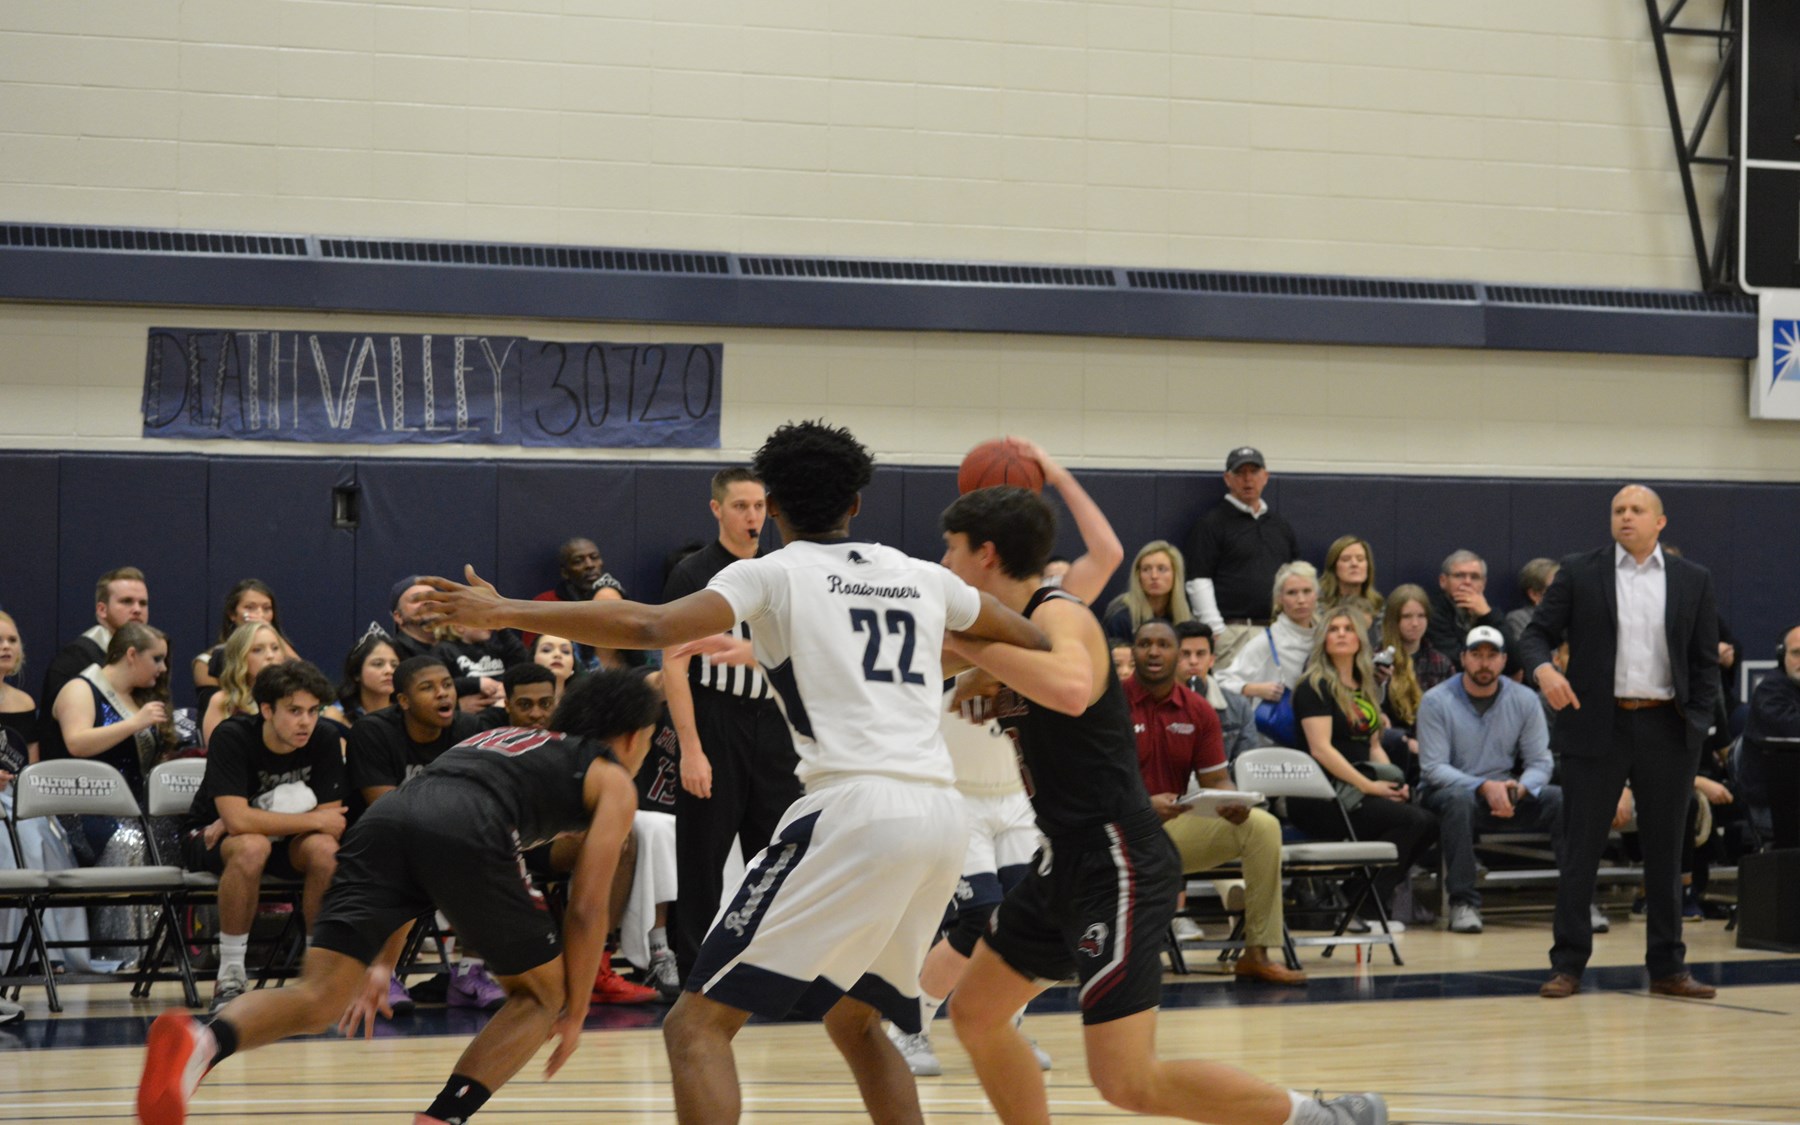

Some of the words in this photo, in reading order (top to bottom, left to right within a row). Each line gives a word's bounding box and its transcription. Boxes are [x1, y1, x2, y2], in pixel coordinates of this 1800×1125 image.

[143, 331, 299, 430] DEATH
[308, 334, 517, 434] VALLEY
[534, 341, 716, 437] 30720
[826, 574, 922, 599] Roadrunners
[848, 607, 926, 686] 22
[29, 774, 77, 787] DALTON
[78, 776, 117, 788] STATE
